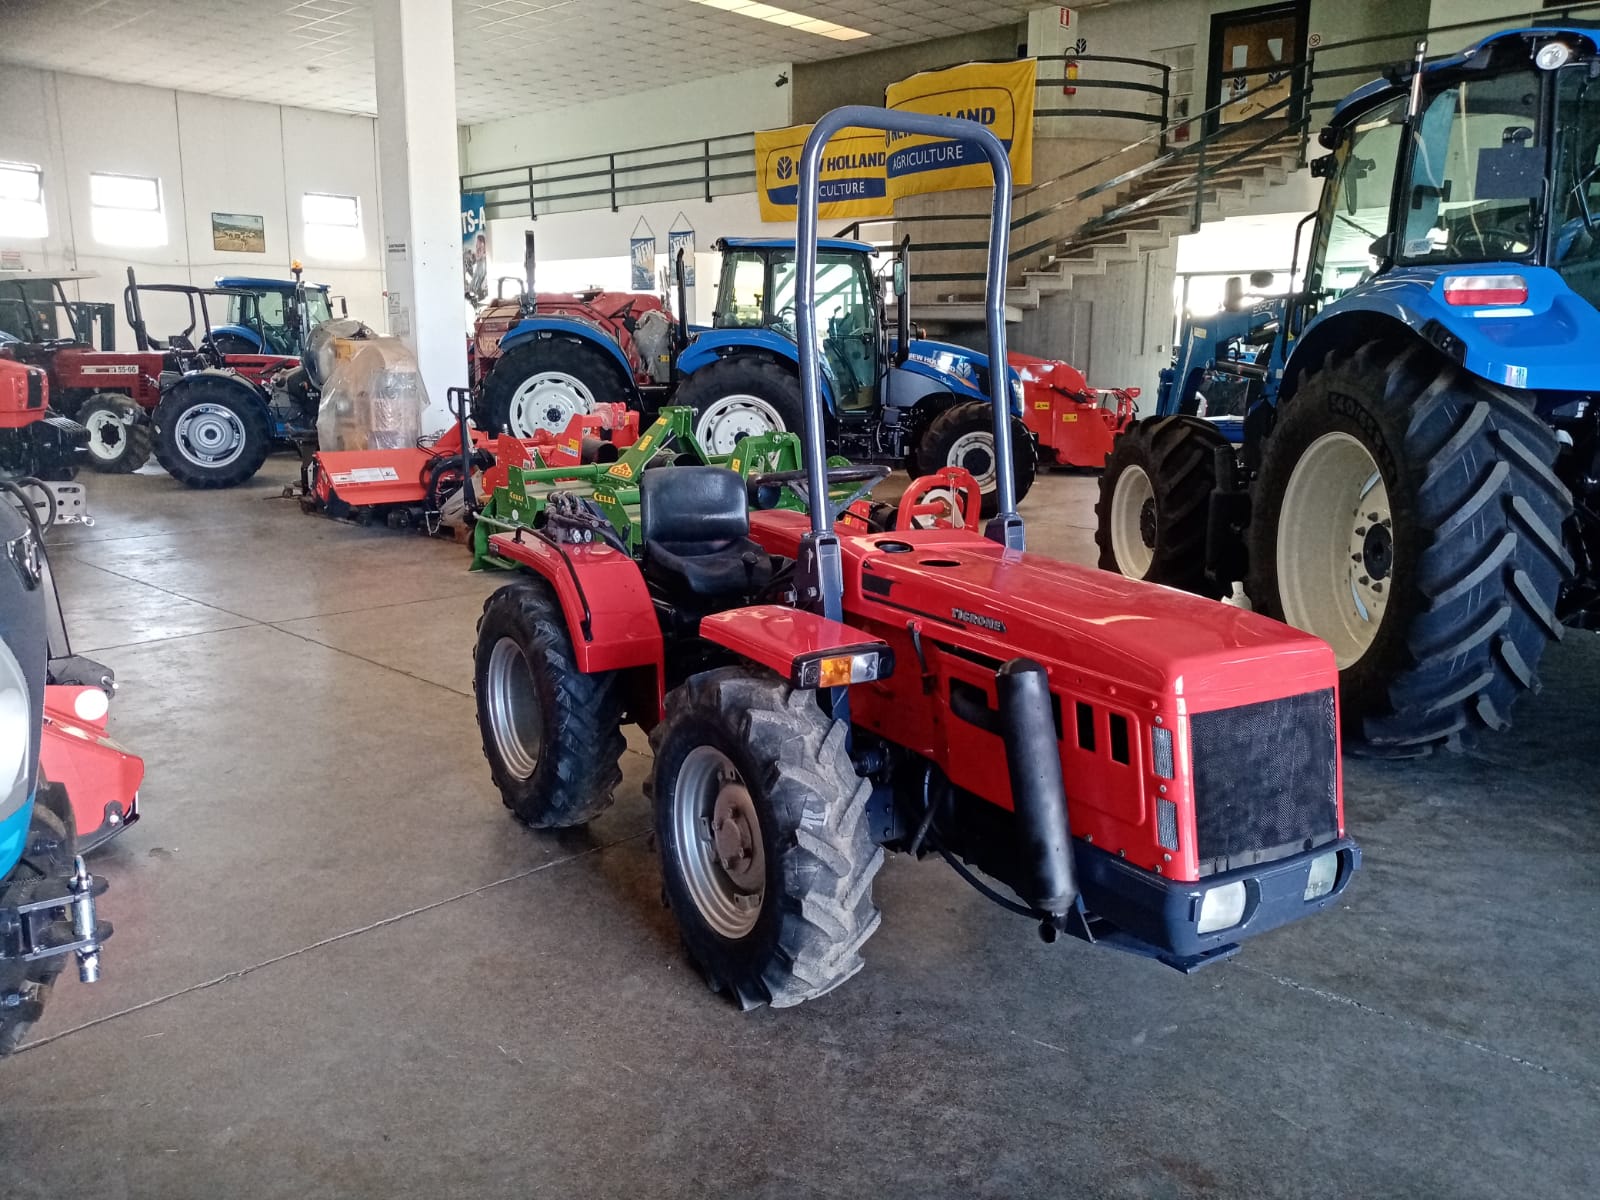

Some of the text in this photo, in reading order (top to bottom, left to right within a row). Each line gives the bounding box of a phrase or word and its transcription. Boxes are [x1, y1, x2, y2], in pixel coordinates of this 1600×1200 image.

[827, 151, 886, 172] HOLLAND
[893, 145, 963, 171] AGRICULTURE
[593, 491, 616, 505] CELLI
